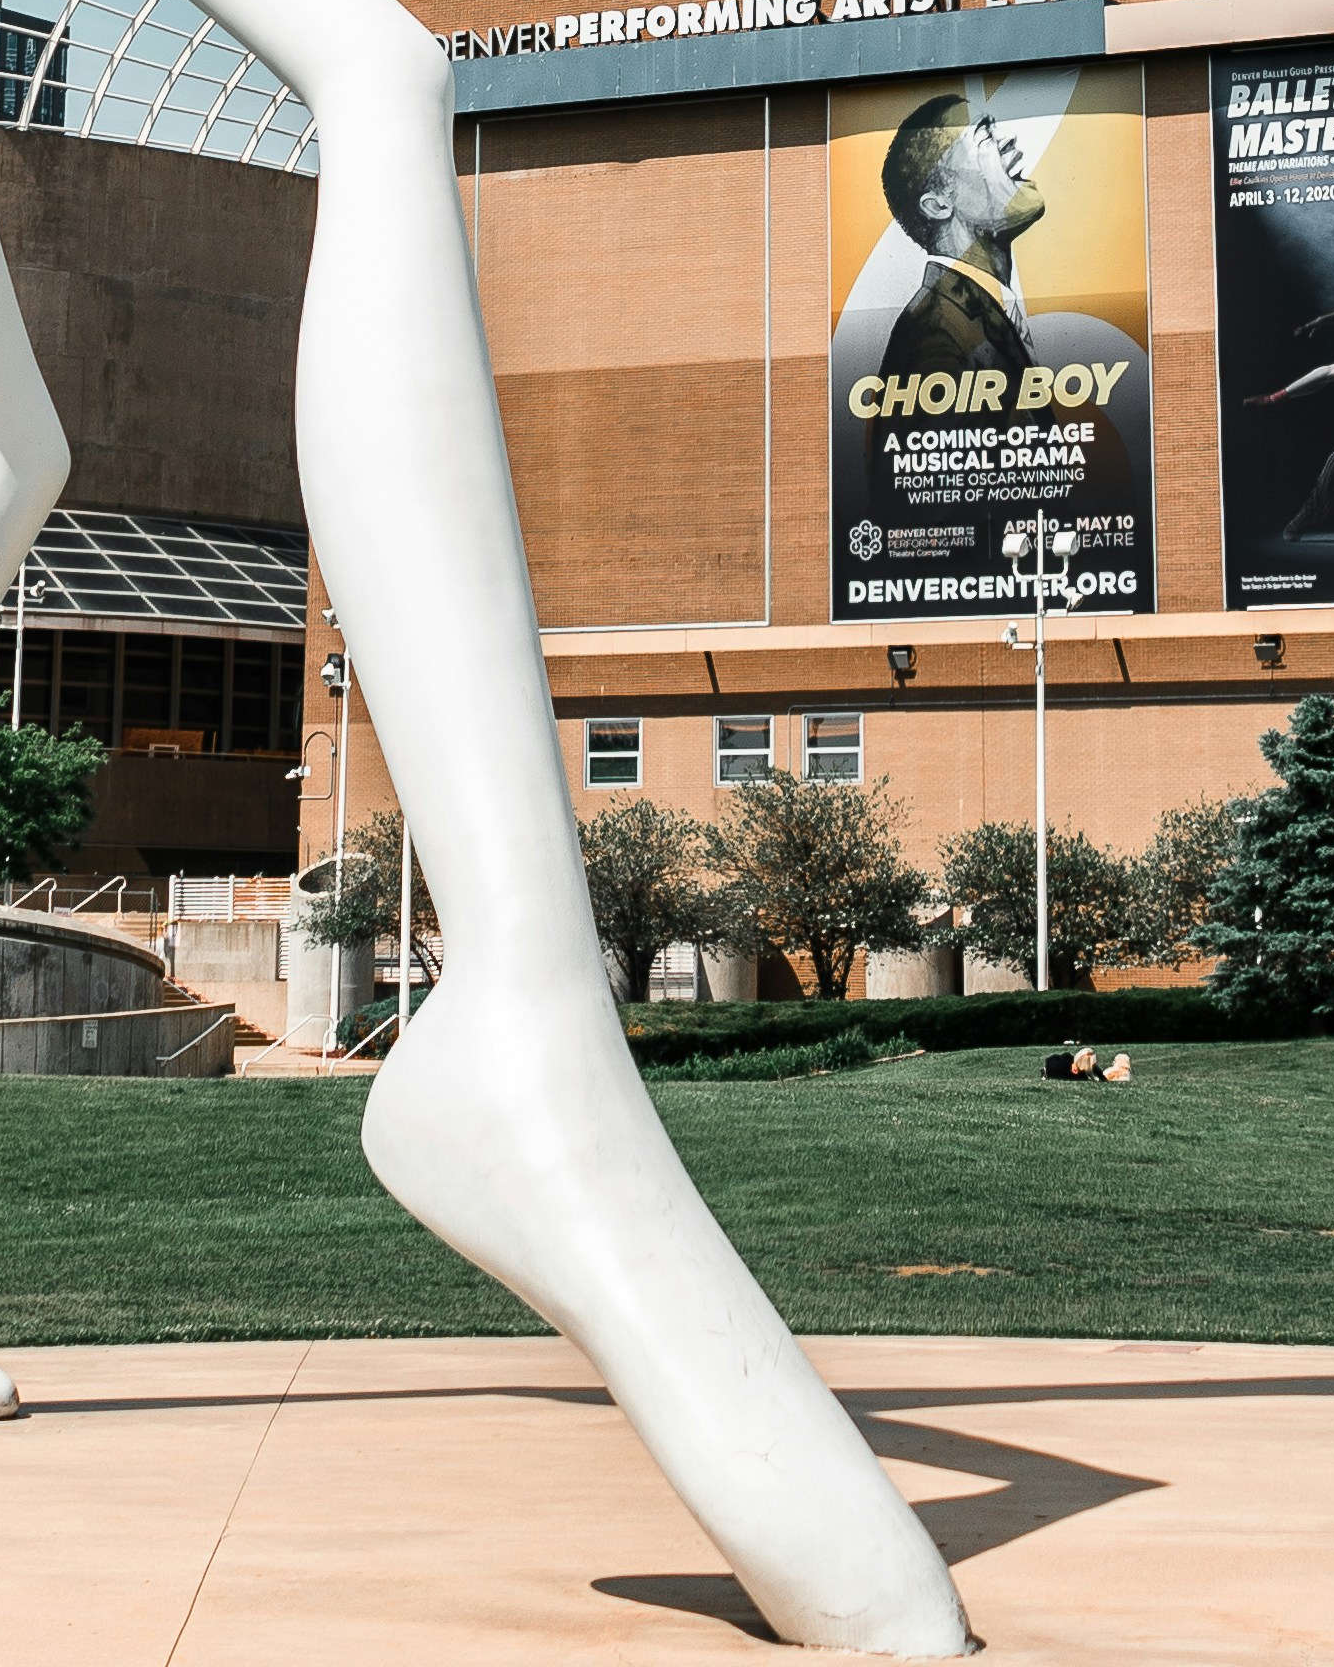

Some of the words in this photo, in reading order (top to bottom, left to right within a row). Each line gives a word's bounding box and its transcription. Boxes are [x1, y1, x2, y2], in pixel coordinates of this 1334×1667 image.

[1228, 160, 1257, 173] THEME
[1257, 159, 1278, 171] AND
[1278, 155, 1329, 170] VARIATIONS
[1229, 190, 1265, 207] APRIL
[1266, 189, 1275, 205] 3
[1284, 187, 1304, 204] 12,
[848, 370, 1007, 419] CHOIR
[1016, 361, 1130, 410] BOY
[884, 433, 900, 452] A
[906, 422, 1095, 451] COMING-OF-AGE
[893, 449, 995, 474] MUSICAL
[1000, 445, 1086, 468] DRAMA
[894, 475, 934, 489] FROM
[938, 473, 965, 487] THE
[968, 468, 1085, 485] OSCAR-WINNING
[908, 490, 961, 504] WRITER
[964, 488, 984, 501] OF
[988, 484, 1073, 501] MOONLIGHT
[888, 528, 926, 539] DENVER
[927, 526, 965, 538] CENTER
[1004, 520, 1037, 534] APR
[1042, 518, 1060, 533] 10
[1076, 516, 1112, 531] MAY
[1115, 515, 1134, 529] 10
[888, 538, 949, 548] PERFORMING
[950, 536, 975, 547] ARTS
[848, 571, 1137, 604] DENVERCENTERORG
